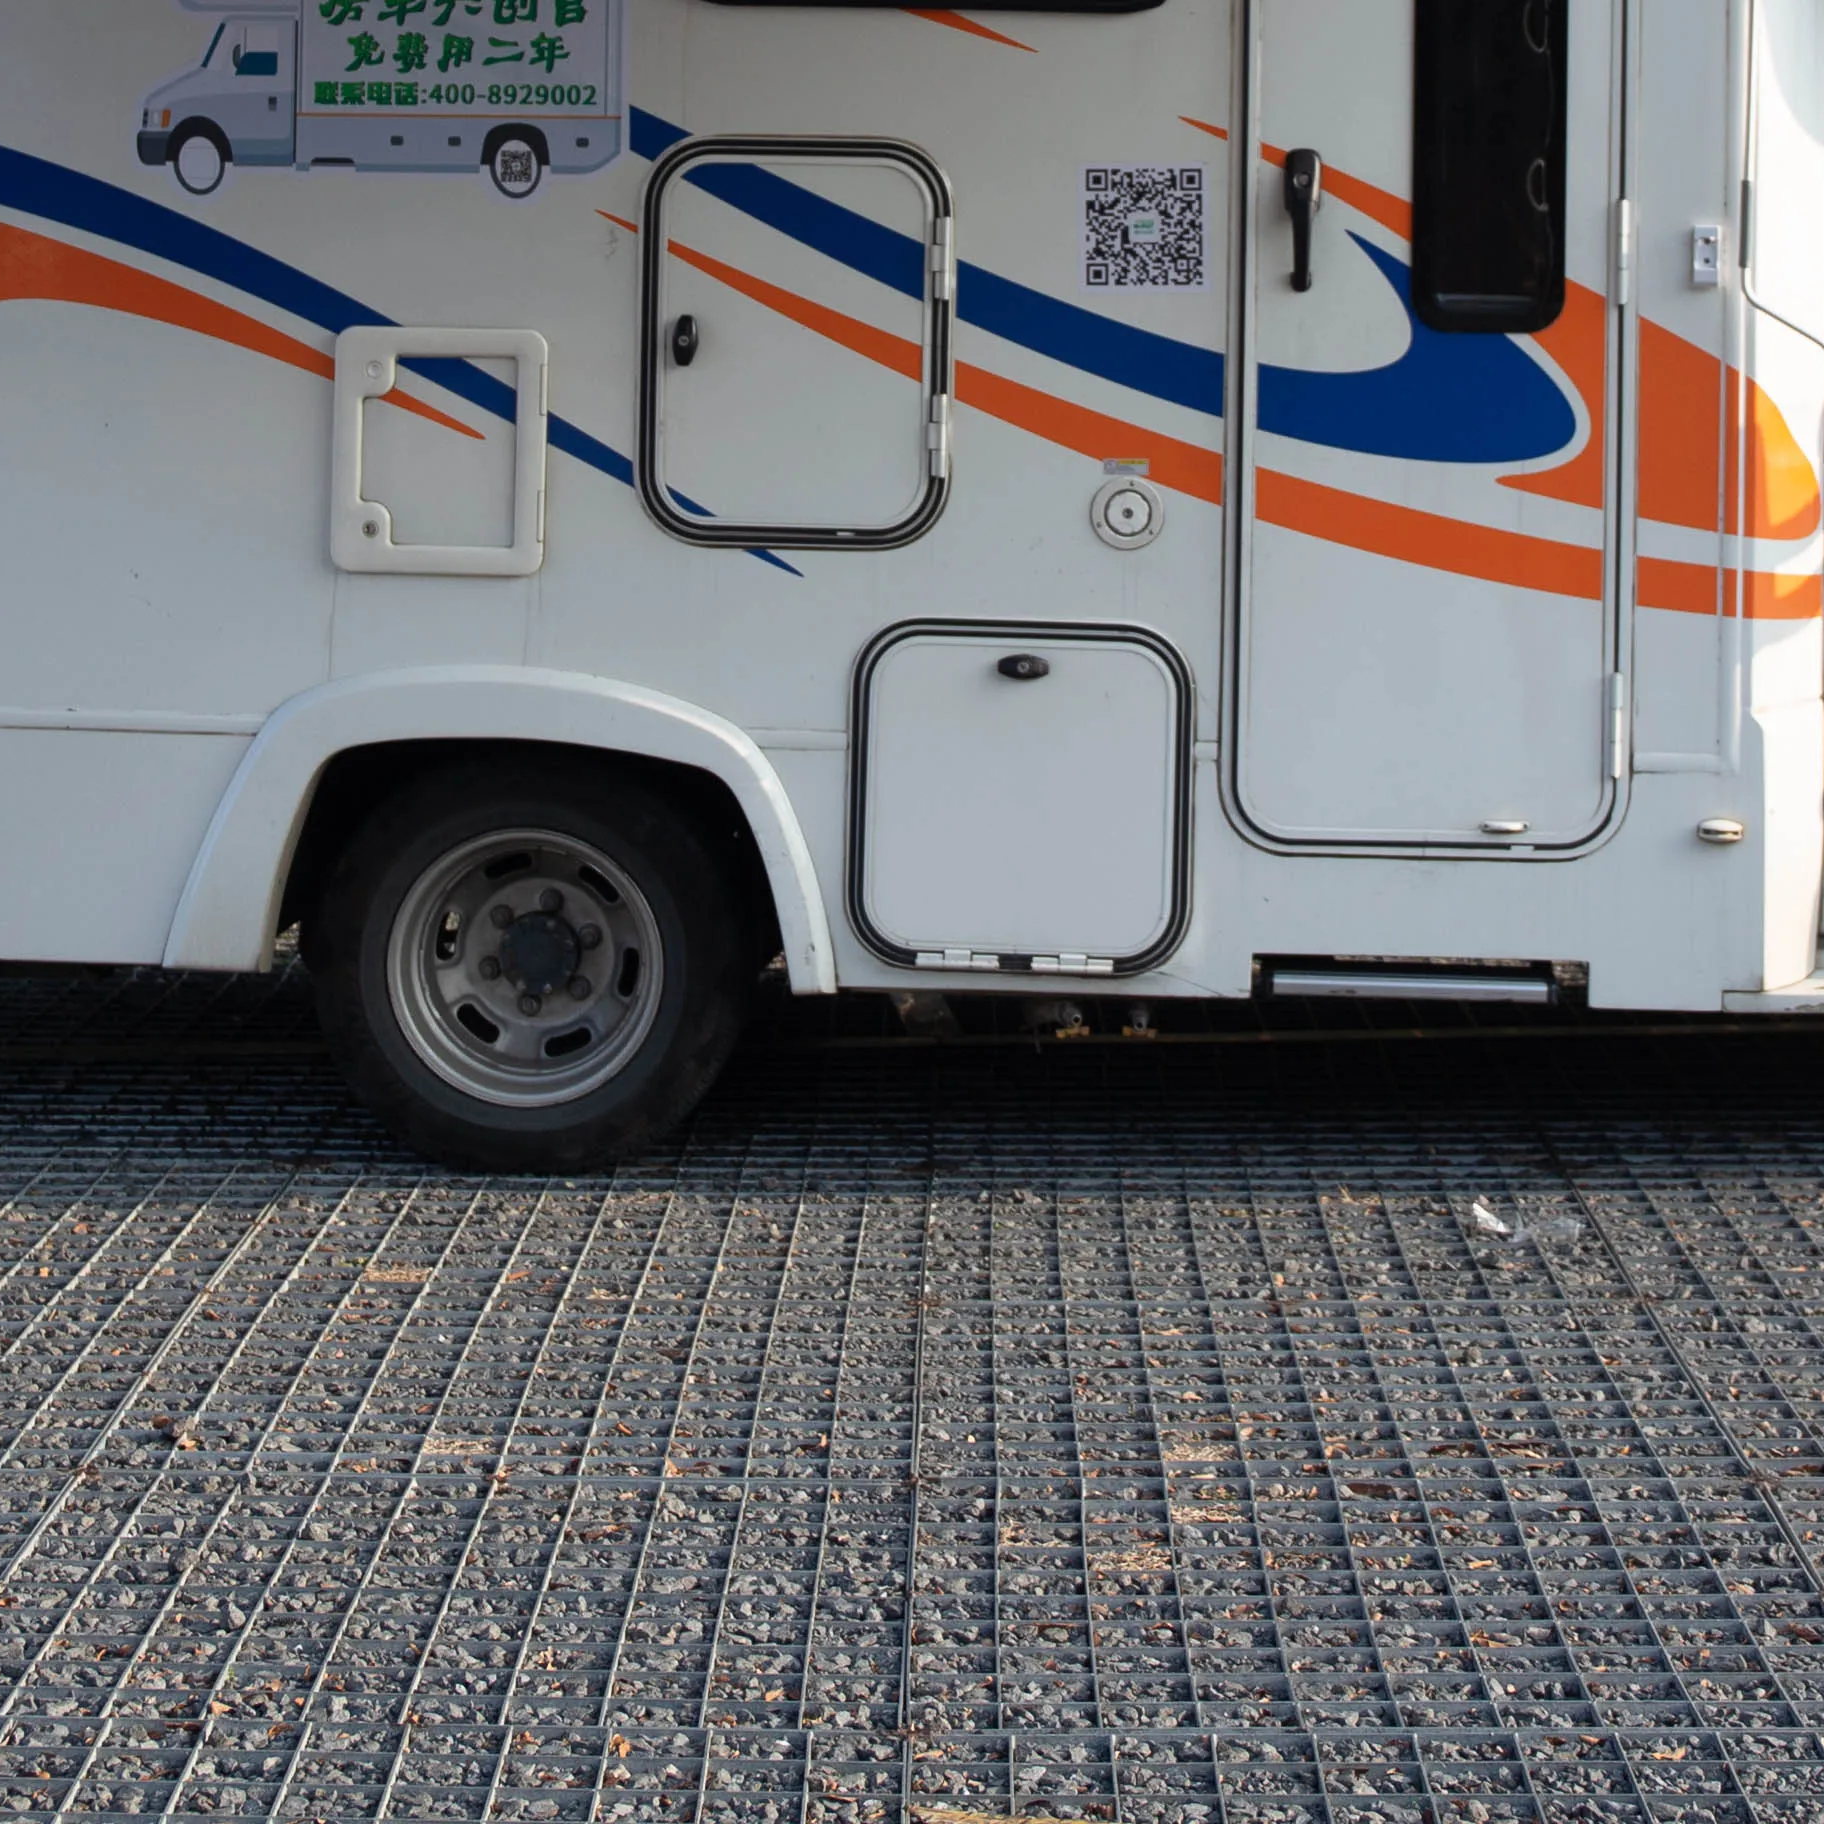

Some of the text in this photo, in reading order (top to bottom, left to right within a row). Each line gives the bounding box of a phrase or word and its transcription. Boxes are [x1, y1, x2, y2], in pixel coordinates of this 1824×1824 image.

[344, 31, 571, 74] 免费用二年
